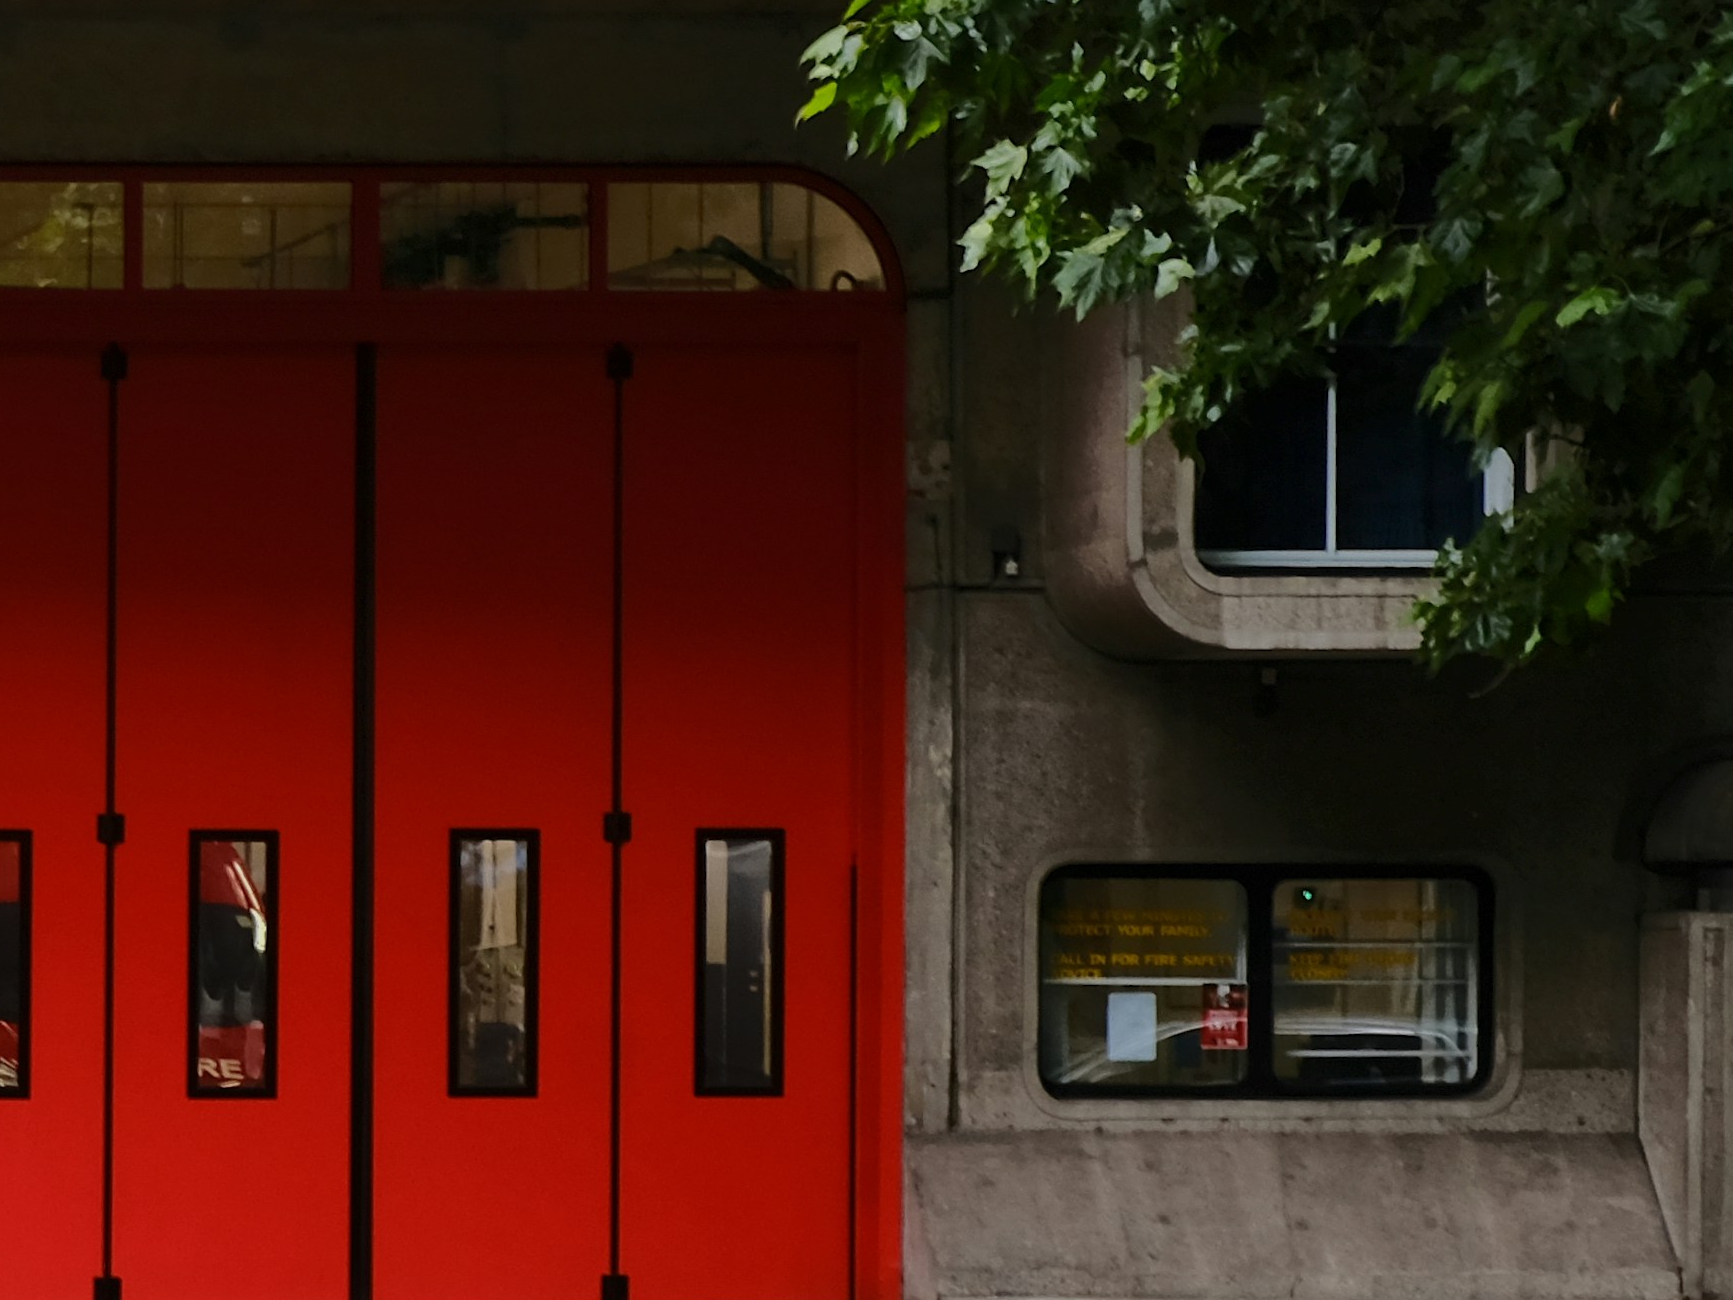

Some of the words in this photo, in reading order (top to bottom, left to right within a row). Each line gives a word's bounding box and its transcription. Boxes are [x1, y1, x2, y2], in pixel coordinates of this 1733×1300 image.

[1118, 924, 1154, 936] YOUR
[1089, 954, 1106, 966] IN
[1111, 954, 1139, 966] FOR
[1144, 954, 1177, 966] FIRE
[1183, 954, 1235, 966] SAFETY
